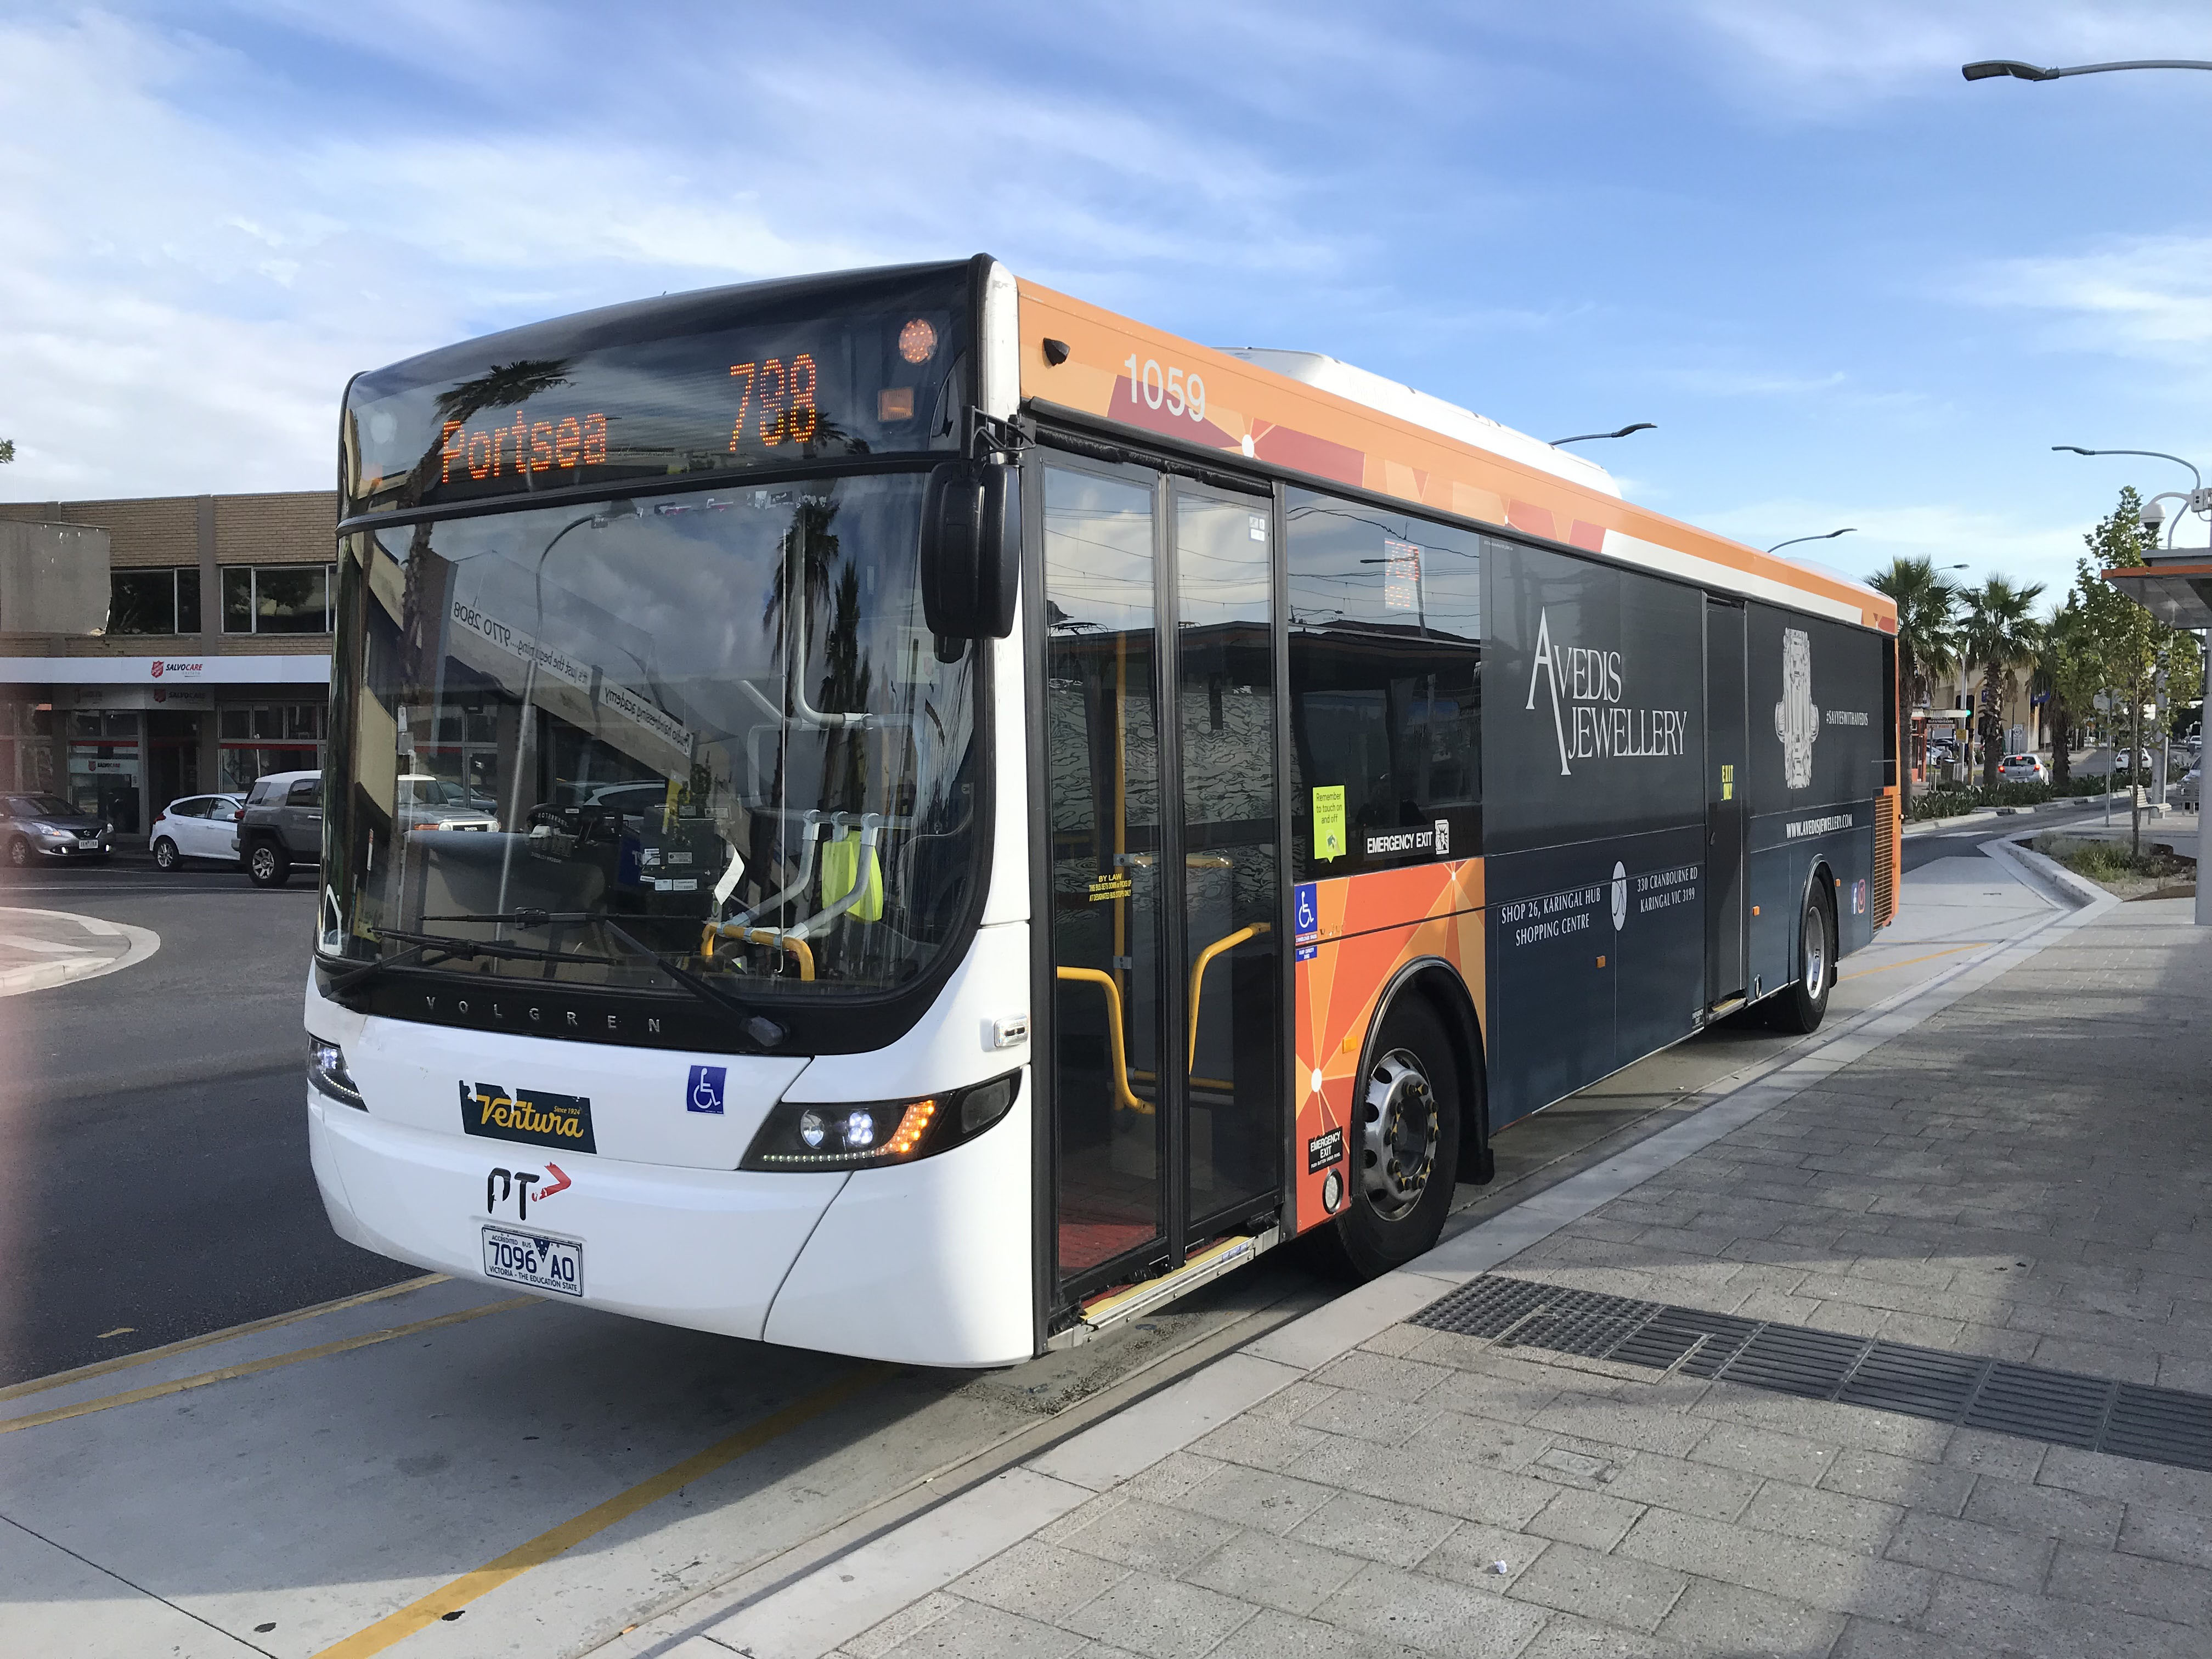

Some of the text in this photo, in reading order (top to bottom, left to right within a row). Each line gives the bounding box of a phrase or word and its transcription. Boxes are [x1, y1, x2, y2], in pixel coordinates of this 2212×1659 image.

[1125, 353, 1205, 422] 1059
[729, 353, 816, 452] 788
[442, 409, 606, 483] Portsea
[1525, 606, 1622, 775] AVEDIS
[1568, 707, 1687, 759] JEWELLERY
[1722, 765, 1733, 783] EXIT
[1317, 793, 1341, 802] Remember
[1323, 804, 1336, 812] touch
[1321, 816, 1330, 824] and
[1367, 831, 1433, 854] EMERGENCY EXIT
[1637, 867, 1697, 892] 330 CRANBOURNE RD
[1502, 887, 1601, 924] SHOP 26, KARINGAL HUB
[1640, 887, 1695, 913] KARINGAL VIC 3199
[1516, 913, 1589, 946] SHOPPING CENTRE
[426, 996, 660, 1032] VOLGREN
[467, 1094, 584, 1138] Ventura
[554, 1105, 567, 1114] Since
[1310, 1131, 1341, 1152] EMERGENCY
[1320, 1145, 1332, 1159] EXIT
[492, 1234, 518, 1245] ACCREDITED
[489, 1240, 537, 1273] 7096
[489, 1266, 514, 1277] VICTORIA
[518, 1272, 528, 1280] THE
[530, 1275, 561, 1288] EDUCATION
[562, 1282, 578, 1292] STATE
